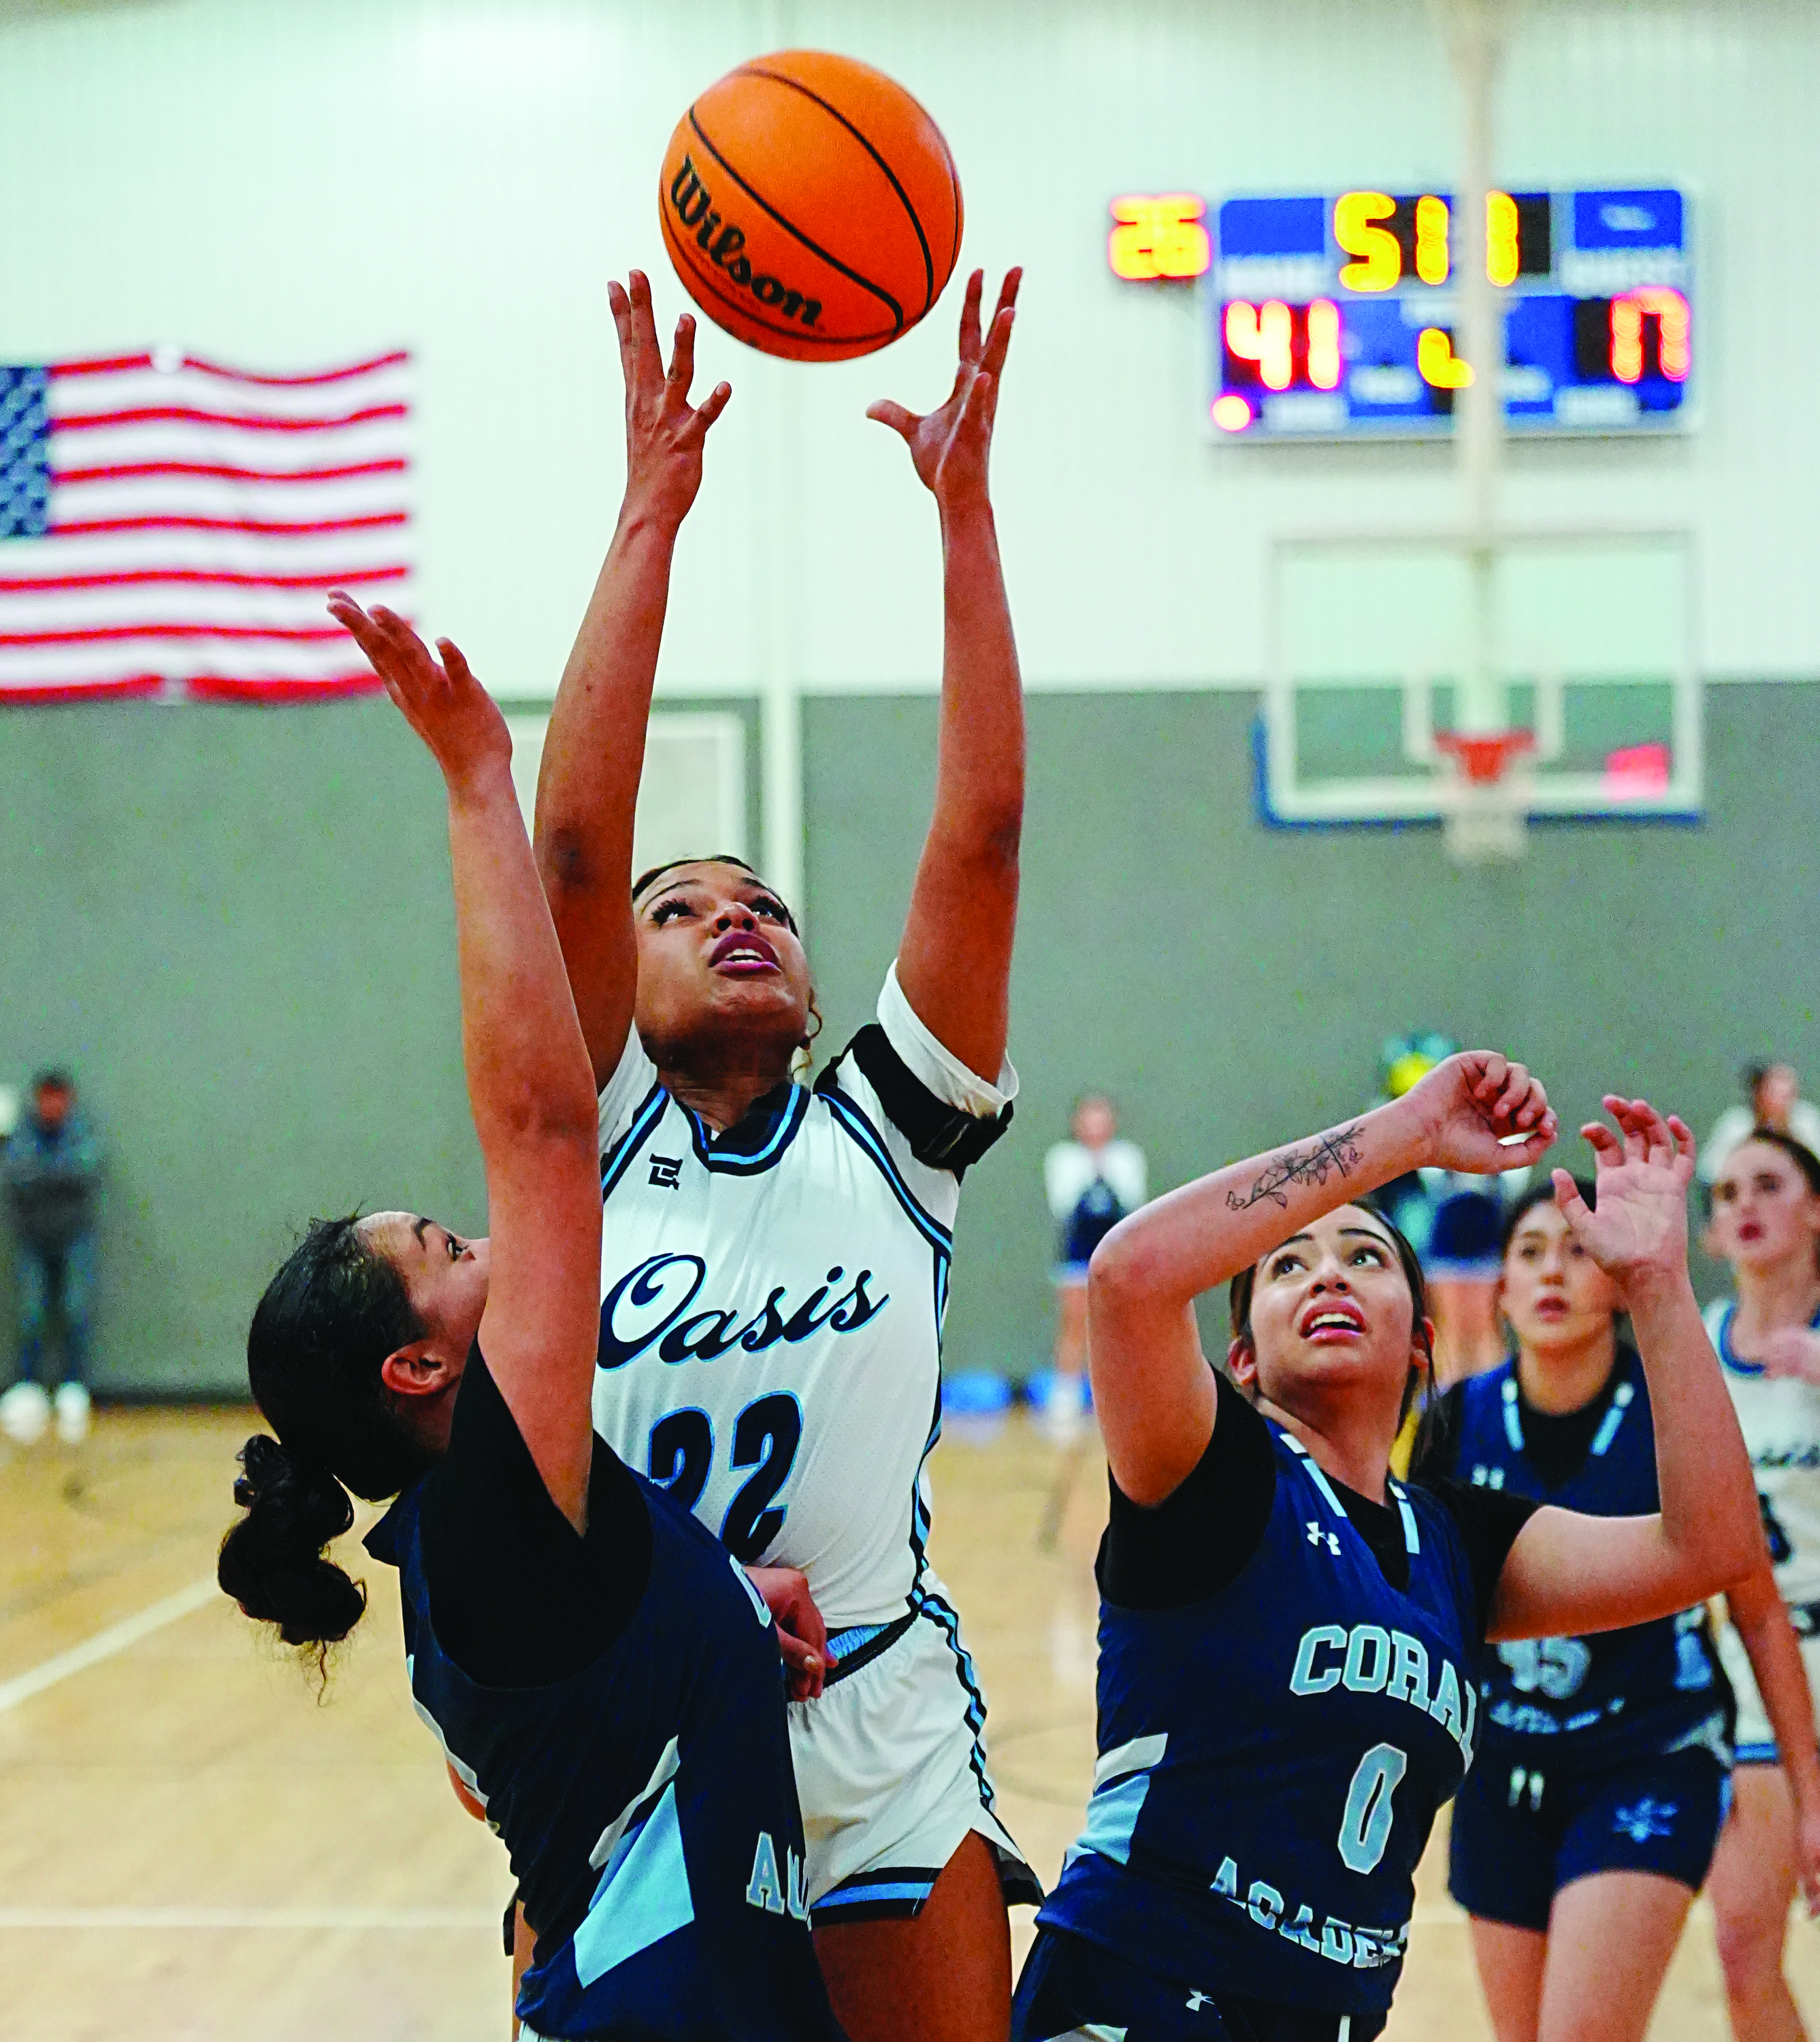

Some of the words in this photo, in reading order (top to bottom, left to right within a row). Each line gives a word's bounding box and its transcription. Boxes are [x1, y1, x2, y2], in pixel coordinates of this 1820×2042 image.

[670, 155, 822, 327] Wilson
[1225, 299, 1340, 390] 41
[596, 1252, 890, 1371] Oasis
[647, 1390, 805, 1564] 22
[1337, 1742, 1408, 1876] 0
